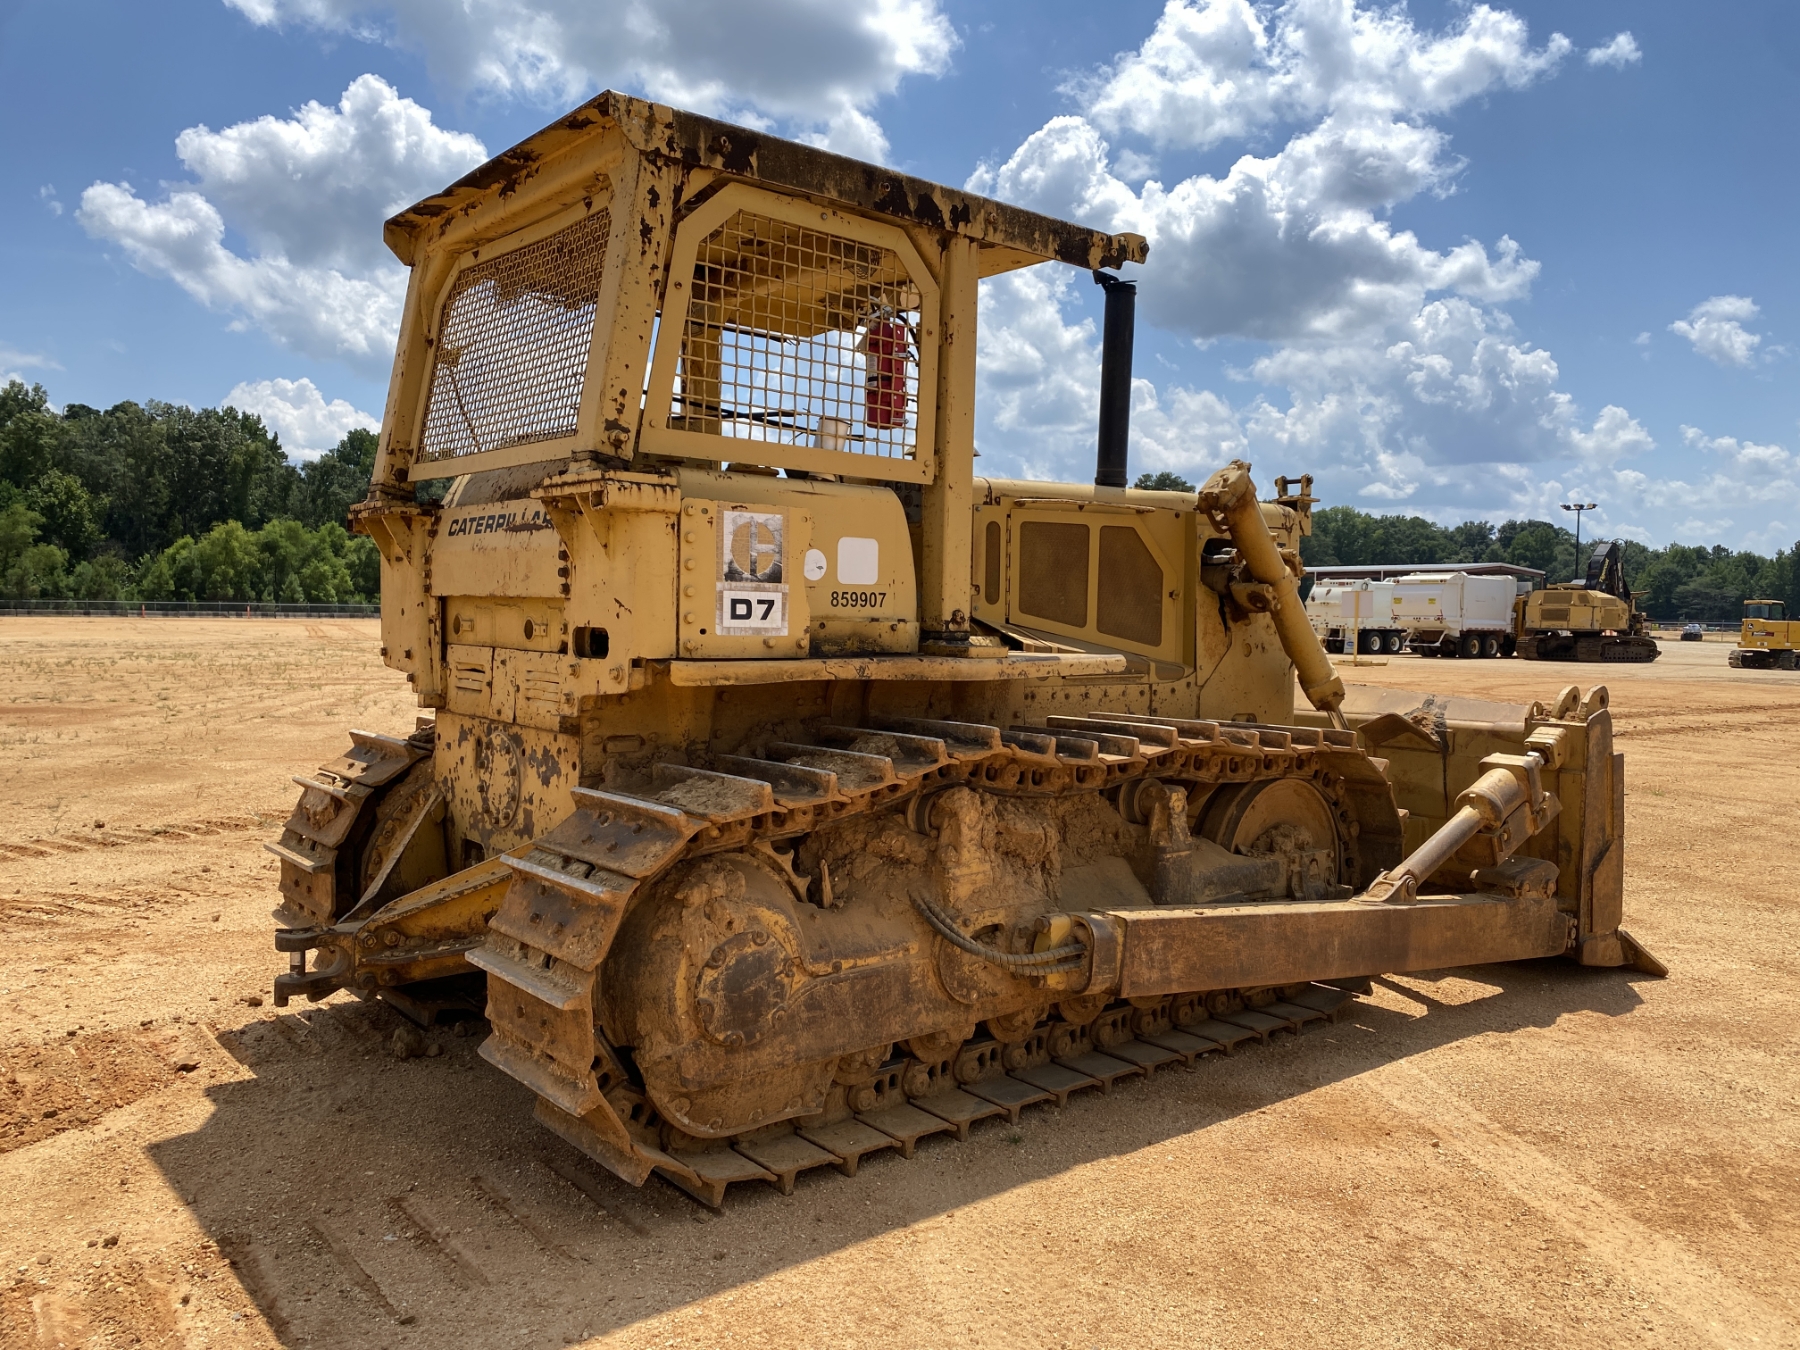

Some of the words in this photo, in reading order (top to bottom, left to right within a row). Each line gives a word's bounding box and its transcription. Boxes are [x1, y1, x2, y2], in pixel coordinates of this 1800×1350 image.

[448, 510, 554, 537] CATERPIA
[730, 598, 775, 621] D7
[830, 591, 887, 608] 859907
